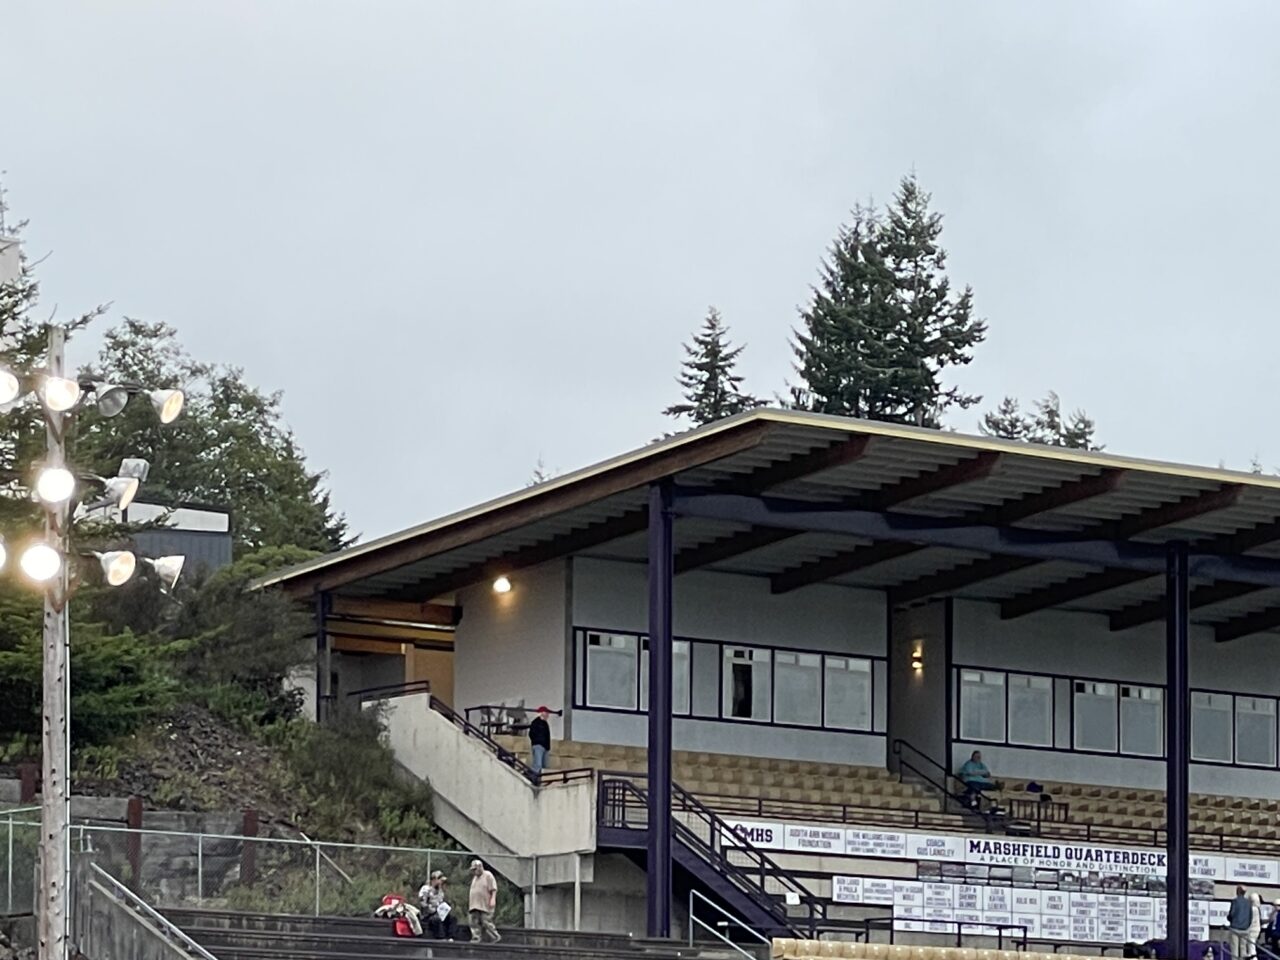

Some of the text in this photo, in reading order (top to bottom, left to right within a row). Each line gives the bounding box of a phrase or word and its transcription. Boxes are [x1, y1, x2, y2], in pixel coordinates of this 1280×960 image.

[750, 827, 773, 843] MHS
[926, 838, 945, 848] COACH
[916, 847, 929, 856] GUS
[929, 848, 955, 858] LANGLEY
[968, 840, 1167, 867] MARSHFIELD QUARTERDECK
[989, 855, 1019, 864] PLACE
[1022, 858, 1036, 866] OF
[1038, 859, 1073, 868] HONOR
[1075, 862, 1096, 870] AND
[1098, 864, 1158, 874] DISTINCTION
